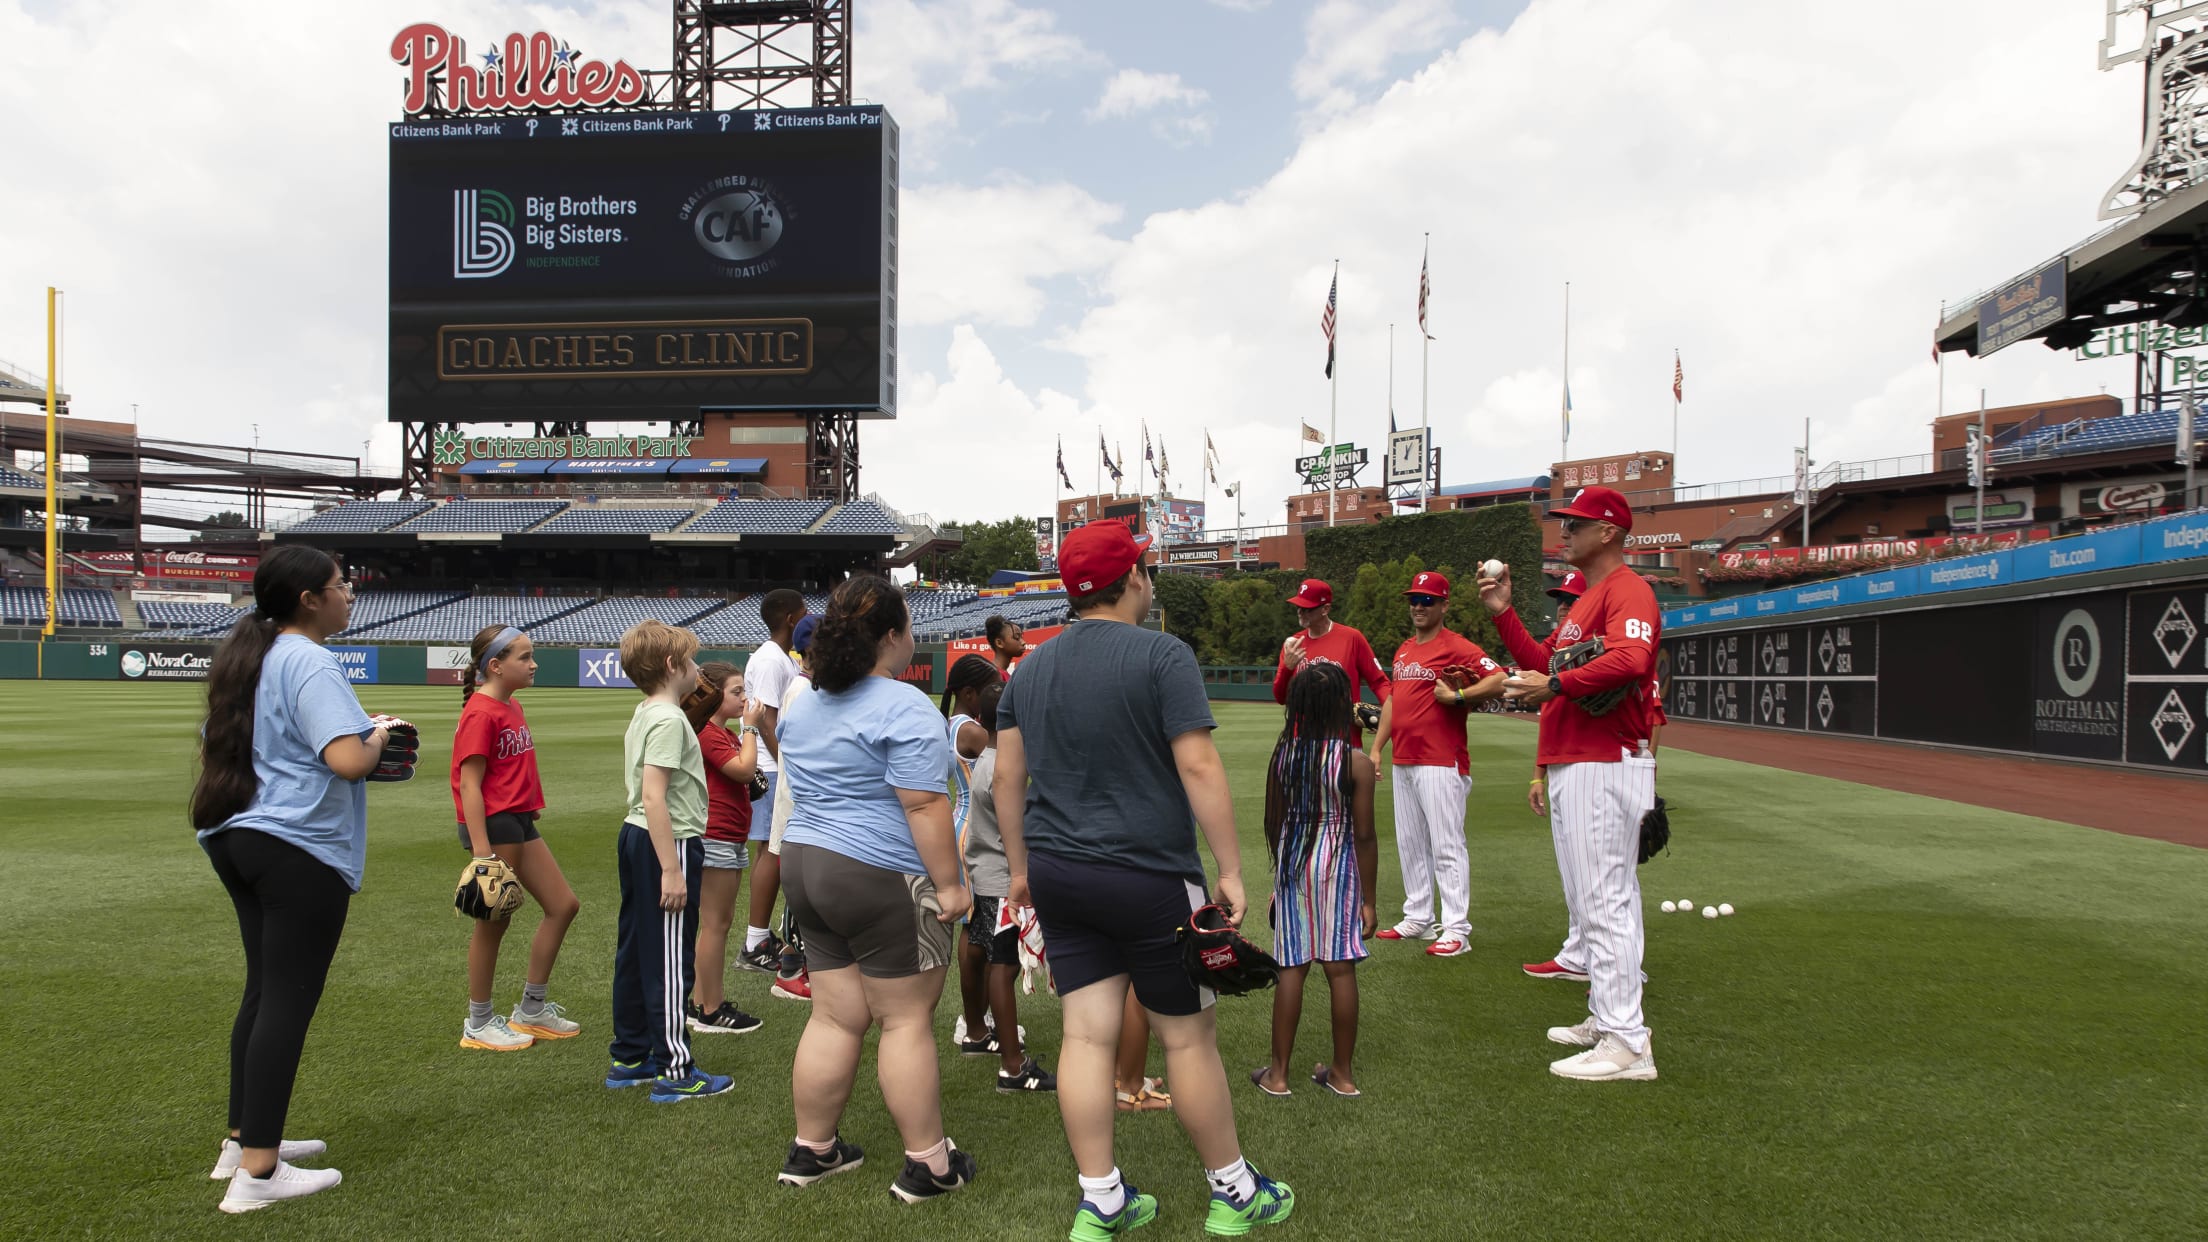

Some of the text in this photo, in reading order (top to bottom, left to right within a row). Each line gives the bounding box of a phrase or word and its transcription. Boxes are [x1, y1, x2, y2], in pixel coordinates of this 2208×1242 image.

[389, 22, 646, 113] Phillies
[583, 117, 693, 132] Citizens Bank Park
[776, 114, 824, 127] Citizens
[827, 113, 857, 125] Bank
[391, 122, 501, 137] Citizens Bank Park
[526, 195, 637, 222] Big Brothers
[703, 210, 773, 243] CAF
[526, 225, 555, 250] Big
[526, 256, 601, 268] INDEPENDENCE
[2082, 323, 2208, 358] Citize
[449, 331, 800, 369] COACHES CLINIC
[471, 433, 692, 459] Citizens Bank Park
[1300, 458, 1316, 470] CP
[1583, 465, 1598, 480] 34
[1603, 463, 1618, 477] 36
[1636, 533, 1682, 545] TOYOTA
[2050, 547, 2096, 569] ibx.com
[1931, 561, 1988, 586] Independence
[1867, 577, 1895, 595] ibx.com
[1625, 618, 1652, 645] 62
[89, 645, 107, 656] 334
[954, 642, 969, 650] Like
[2067, 638, 2087, 666] R
[147, 653, 211, 668] NovaCare
[2035, 699, 2119, 720] ROTHMAN
[2035, 719, 2119, 736] ORTHOPAEDICS
